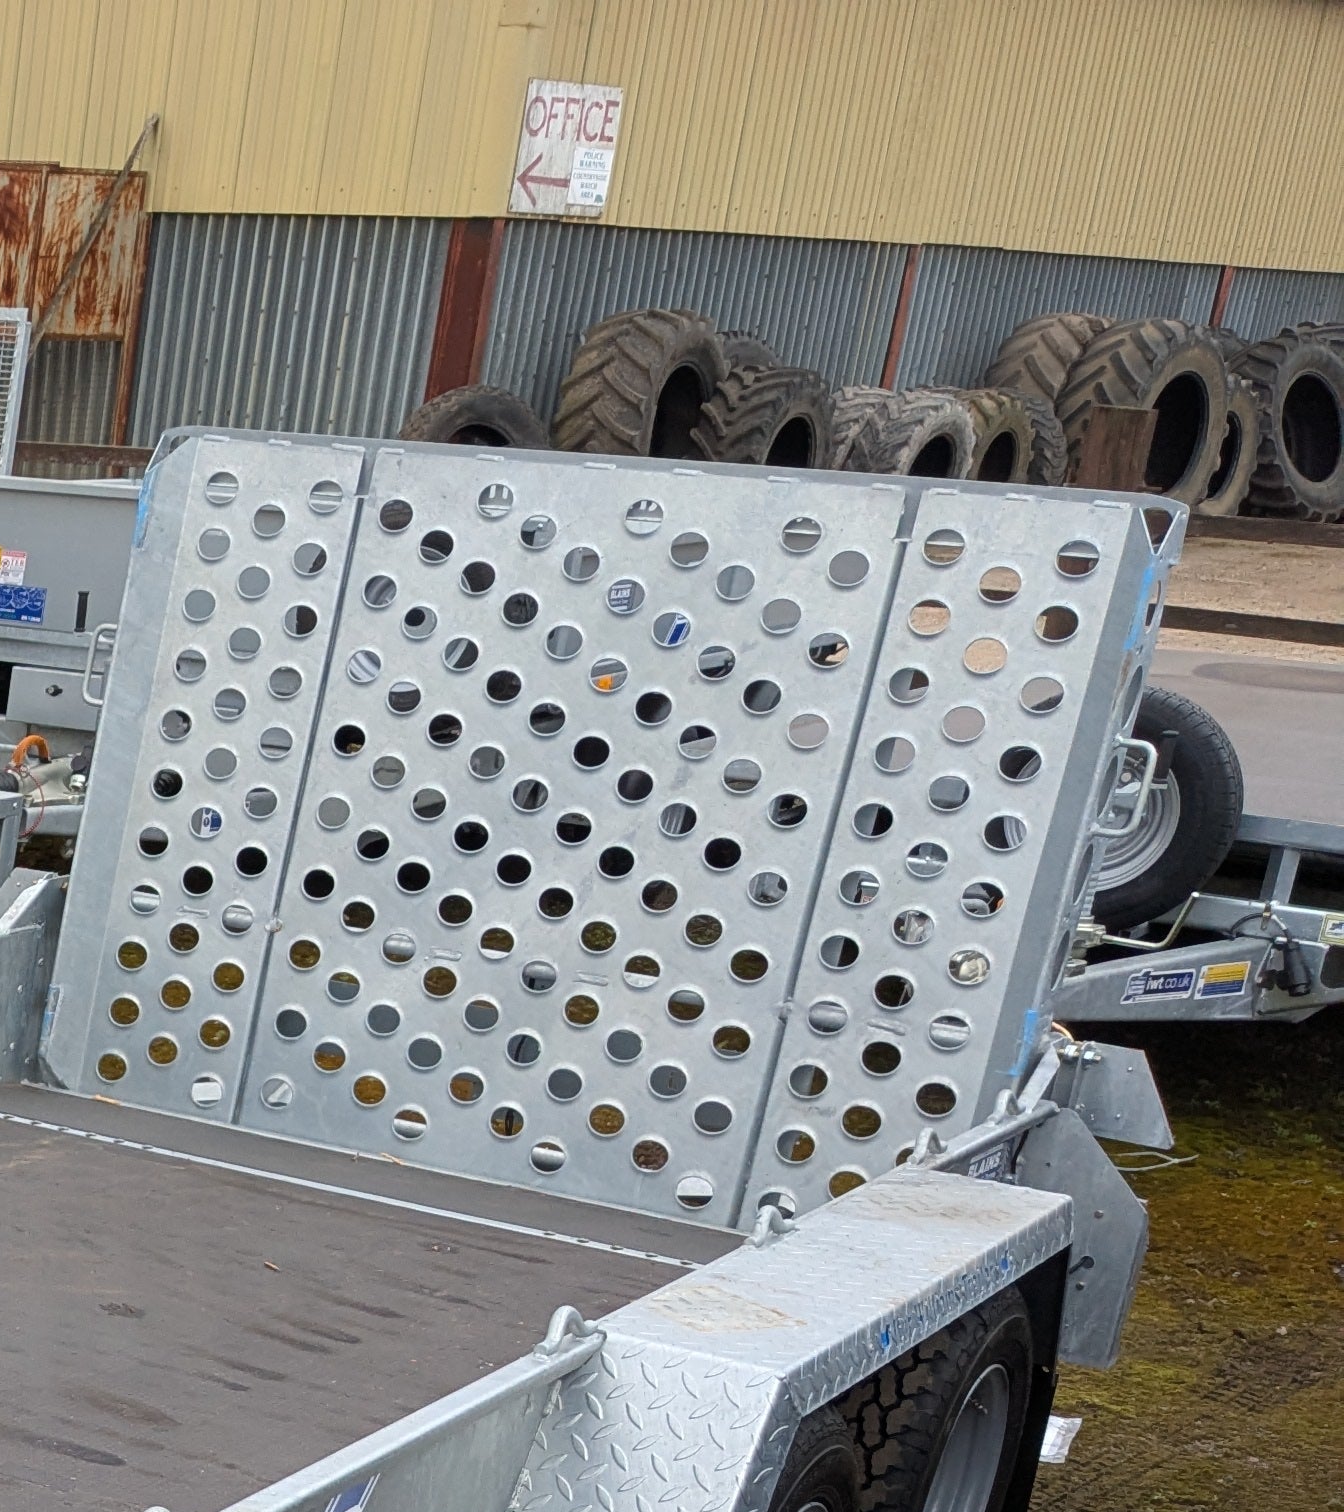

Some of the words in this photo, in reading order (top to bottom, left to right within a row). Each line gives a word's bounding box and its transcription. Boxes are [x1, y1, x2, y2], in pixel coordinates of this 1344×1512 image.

[526, 96, 620, 142] OFFICE
[584, 152, 604, 160] POLICE
[1146, 974, 1192, 991] iwt.co.uk
